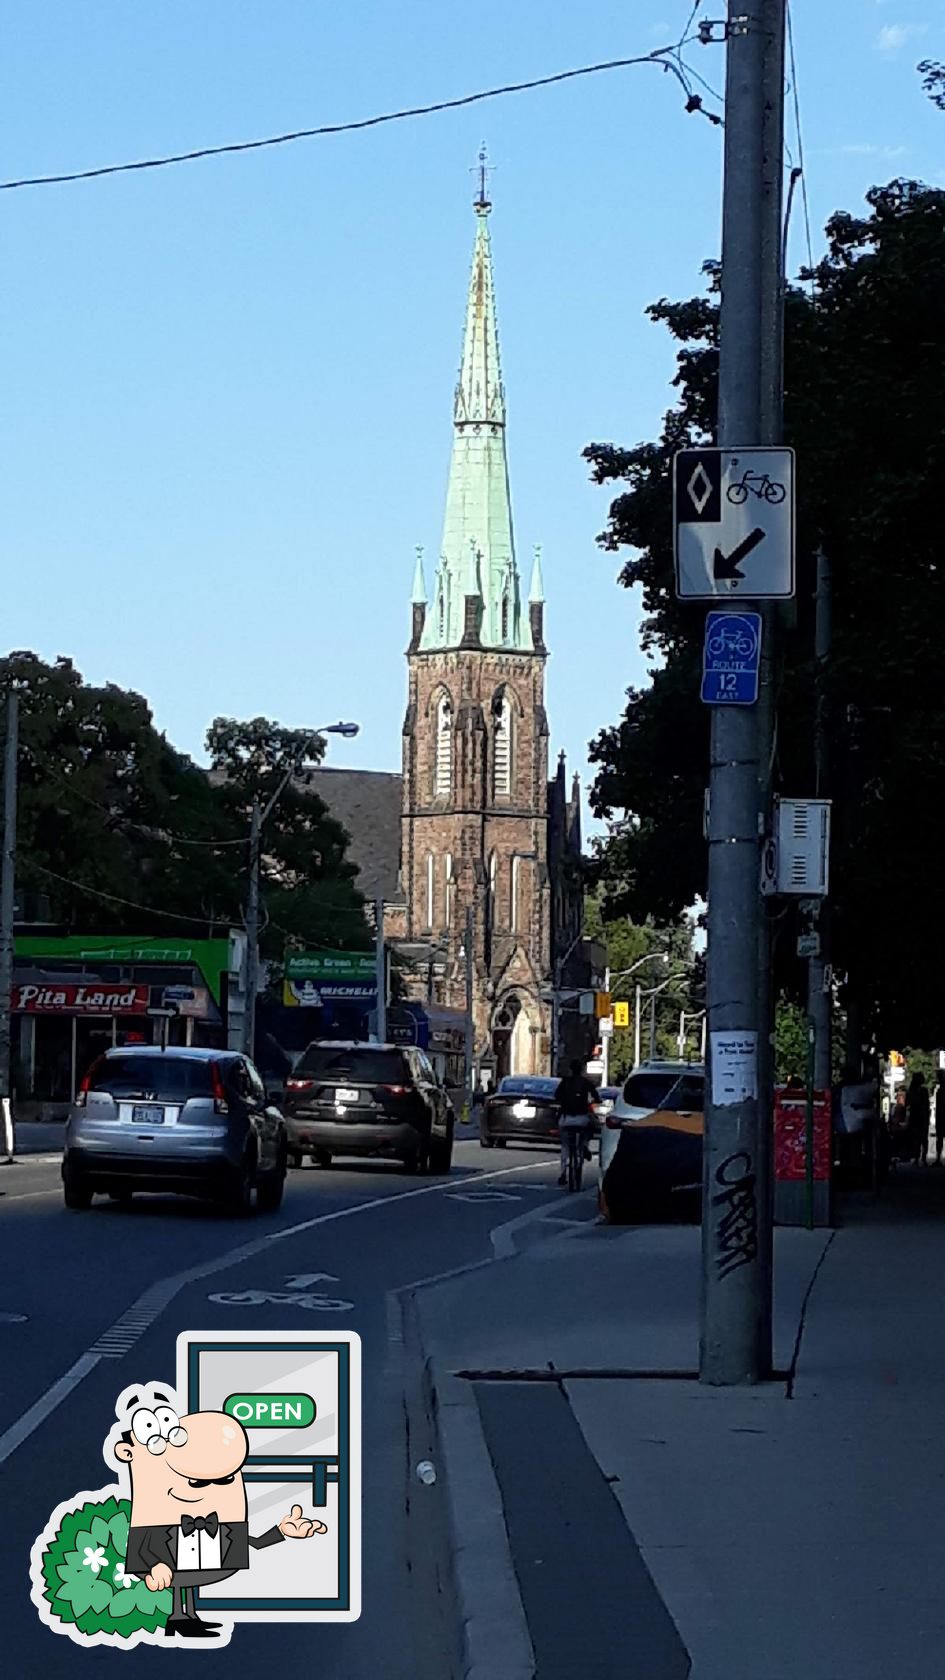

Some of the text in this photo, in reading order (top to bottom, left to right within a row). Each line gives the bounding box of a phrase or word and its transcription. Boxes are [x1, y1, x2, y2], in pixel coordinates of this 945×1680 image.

[712, 661, 745, 670] ROUTE
[720, 674, 737, 690] 12
[323, 958, 351, 967] Green
[18, 985, 136, 1008] Pita Land
